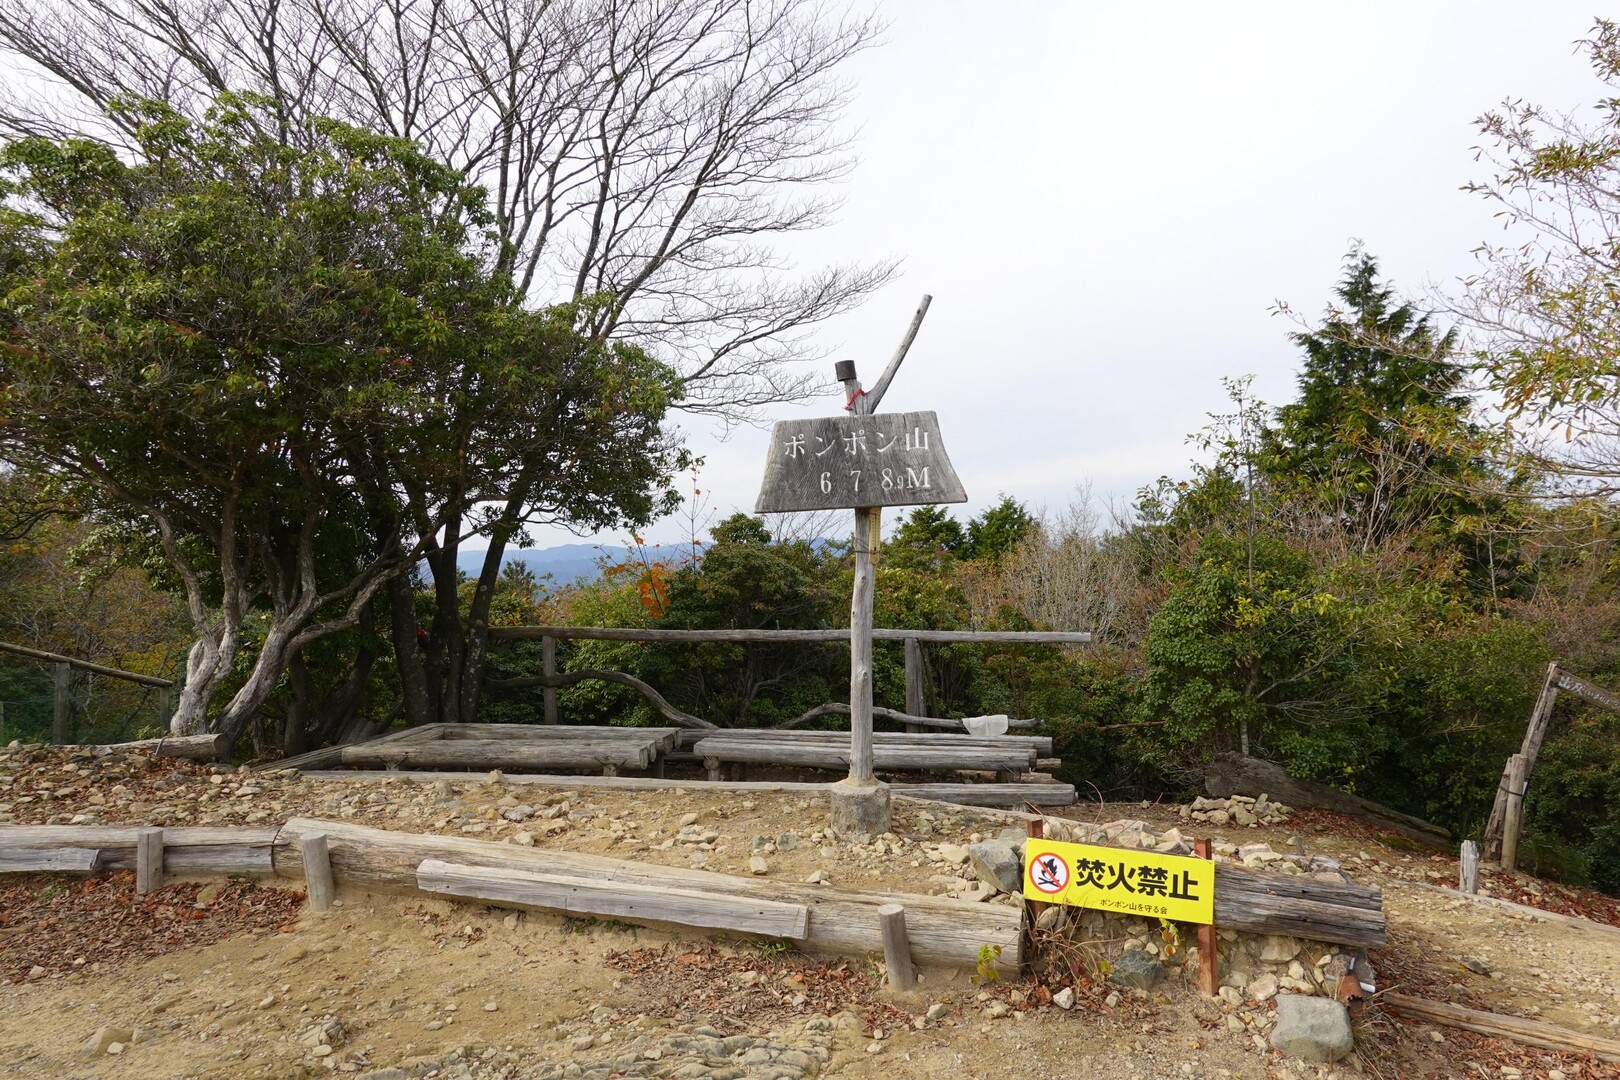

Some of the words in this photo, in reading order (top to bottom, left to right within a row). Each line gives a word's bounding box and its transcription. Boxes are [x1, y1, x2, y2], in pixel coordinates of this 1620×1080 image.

[783, 427, 929, 459] ポンポン山
[1076, 858, 1199, 901] 焚火禁止
